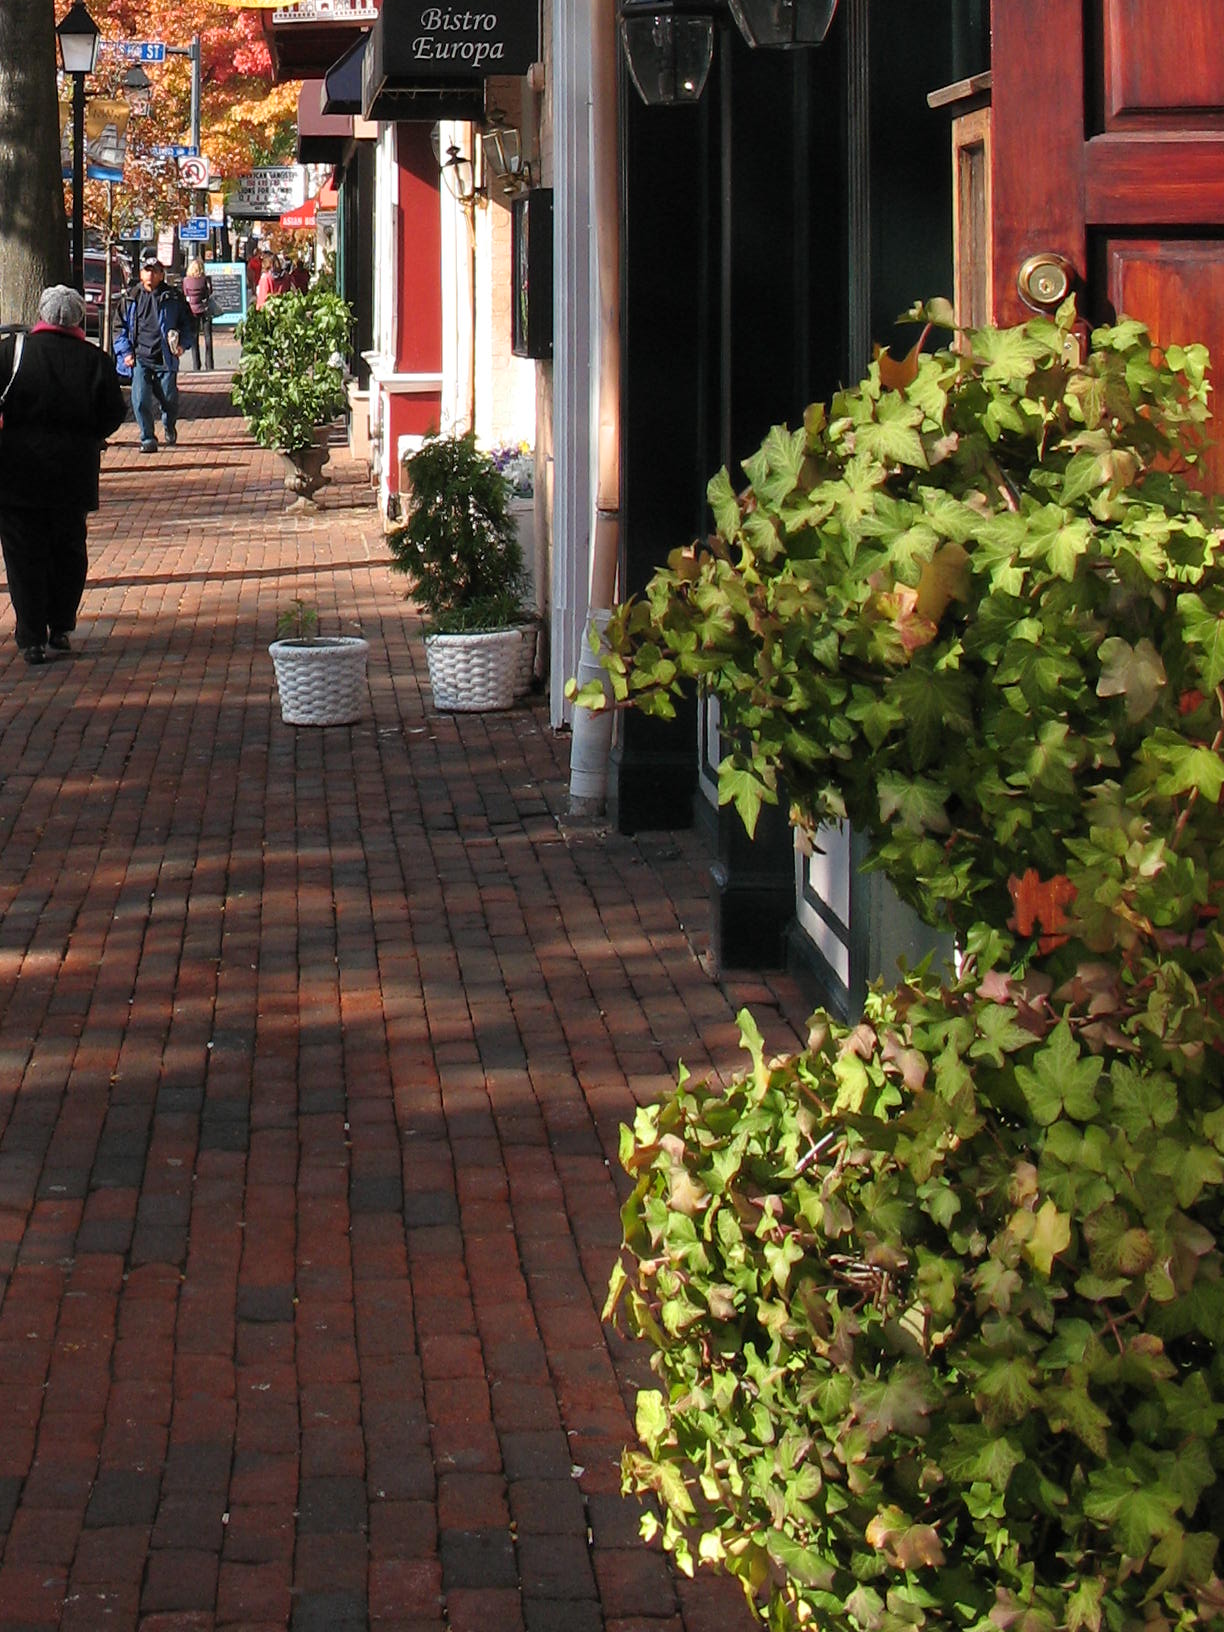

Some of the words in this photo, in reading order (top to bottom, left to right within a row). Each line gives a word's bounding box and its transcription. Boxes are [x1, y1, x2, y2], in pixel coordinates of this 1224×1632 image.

[420, 7, 497, 30] Bistro
[146, 44, 161, 59] ST
[412, 36, 505, 67] Europa
[282, 216, 302, 226] ASIAN
